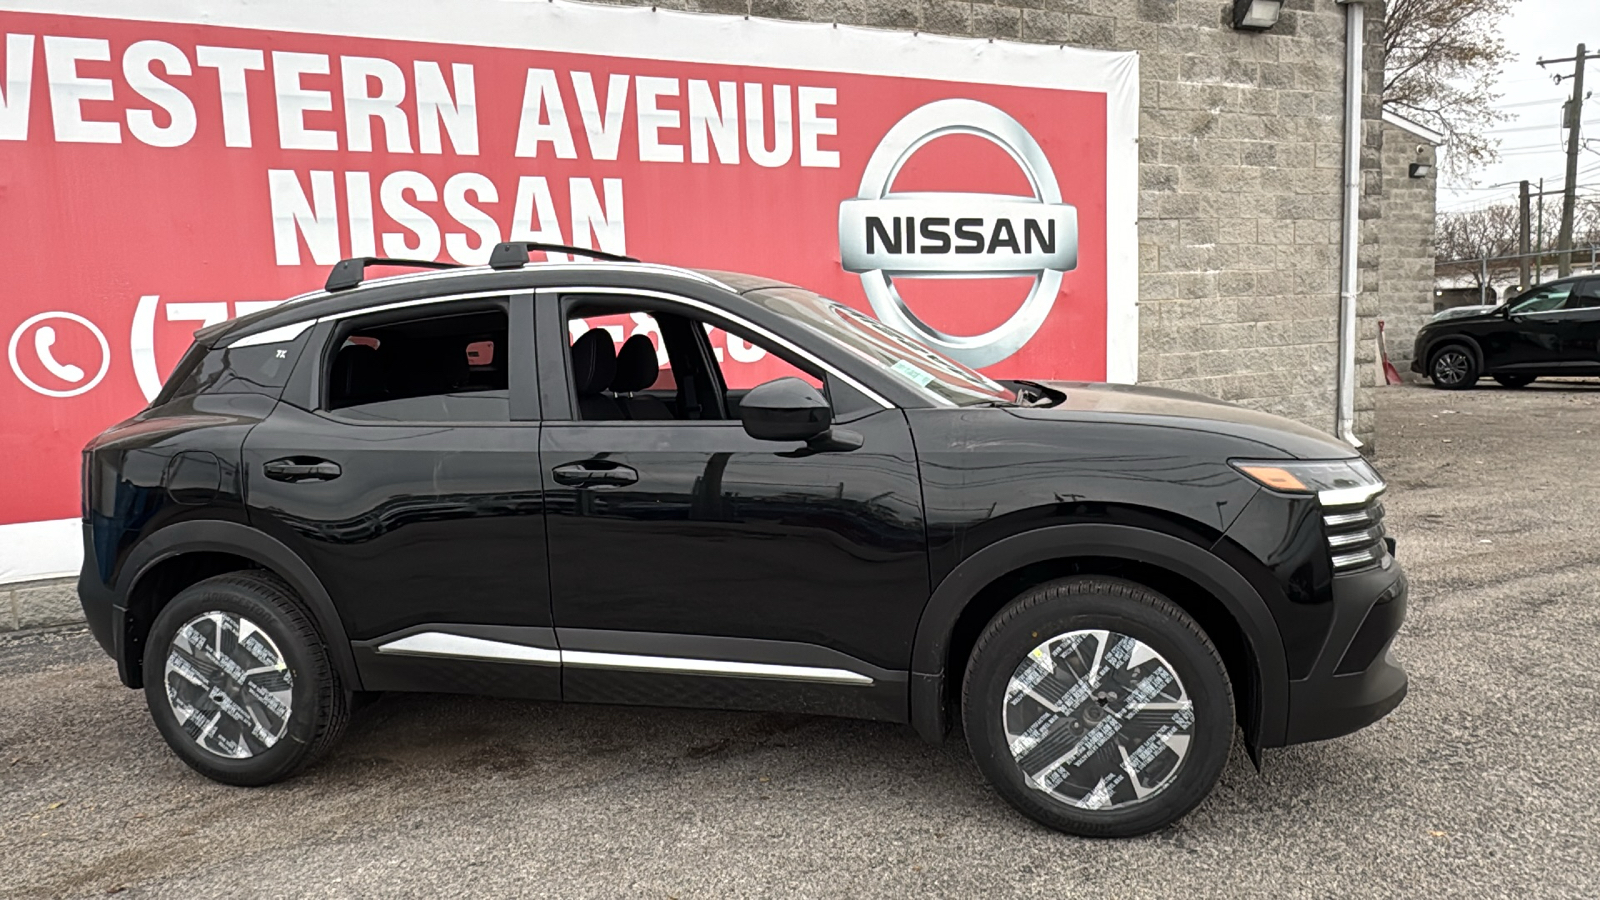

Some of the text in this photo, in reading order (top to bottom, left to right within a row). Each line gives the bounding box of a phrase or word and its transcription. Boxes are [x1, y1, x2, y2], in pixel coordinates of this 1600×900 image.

[515, 68, 840, 168] AVENUE
[268, 169, 625, 267] NISSAN
[866, 217, 1056, 255] NISSAN
